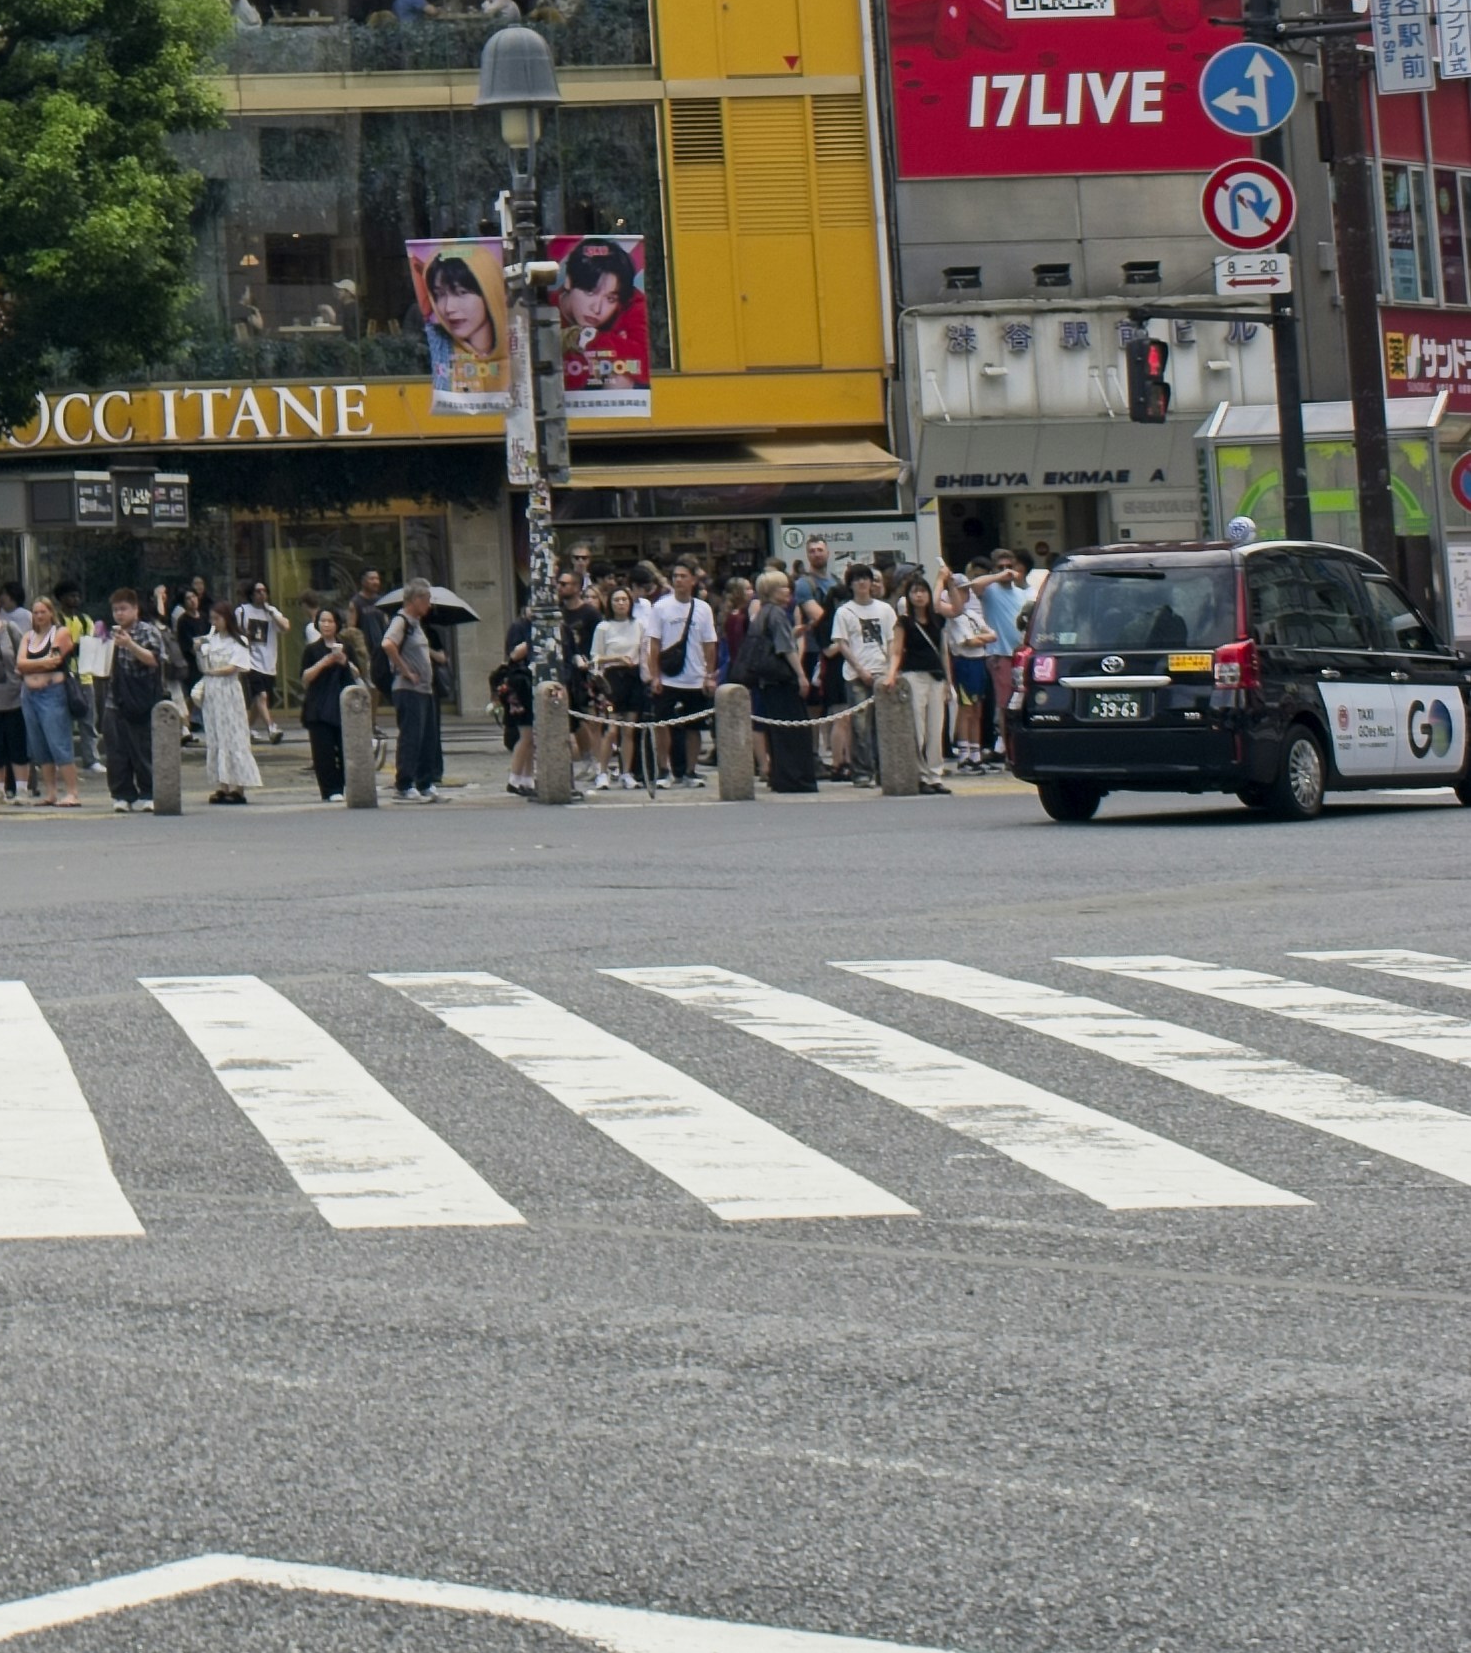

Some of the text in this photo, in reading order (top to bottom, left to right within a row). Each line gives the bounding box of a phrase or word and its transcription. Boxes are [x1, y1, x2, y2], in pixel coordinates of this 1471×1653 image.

[1383, 39, 1397, 68] Sta.
[1260, 258, 1278, 273] 20
[1388, 336, 1405, 375] 薬
[934, 471, 1030, 489] SHIBUYA
[1042, 468, 1131, 486] EKIMAE
[1407, 698, 1454, 760] GO
